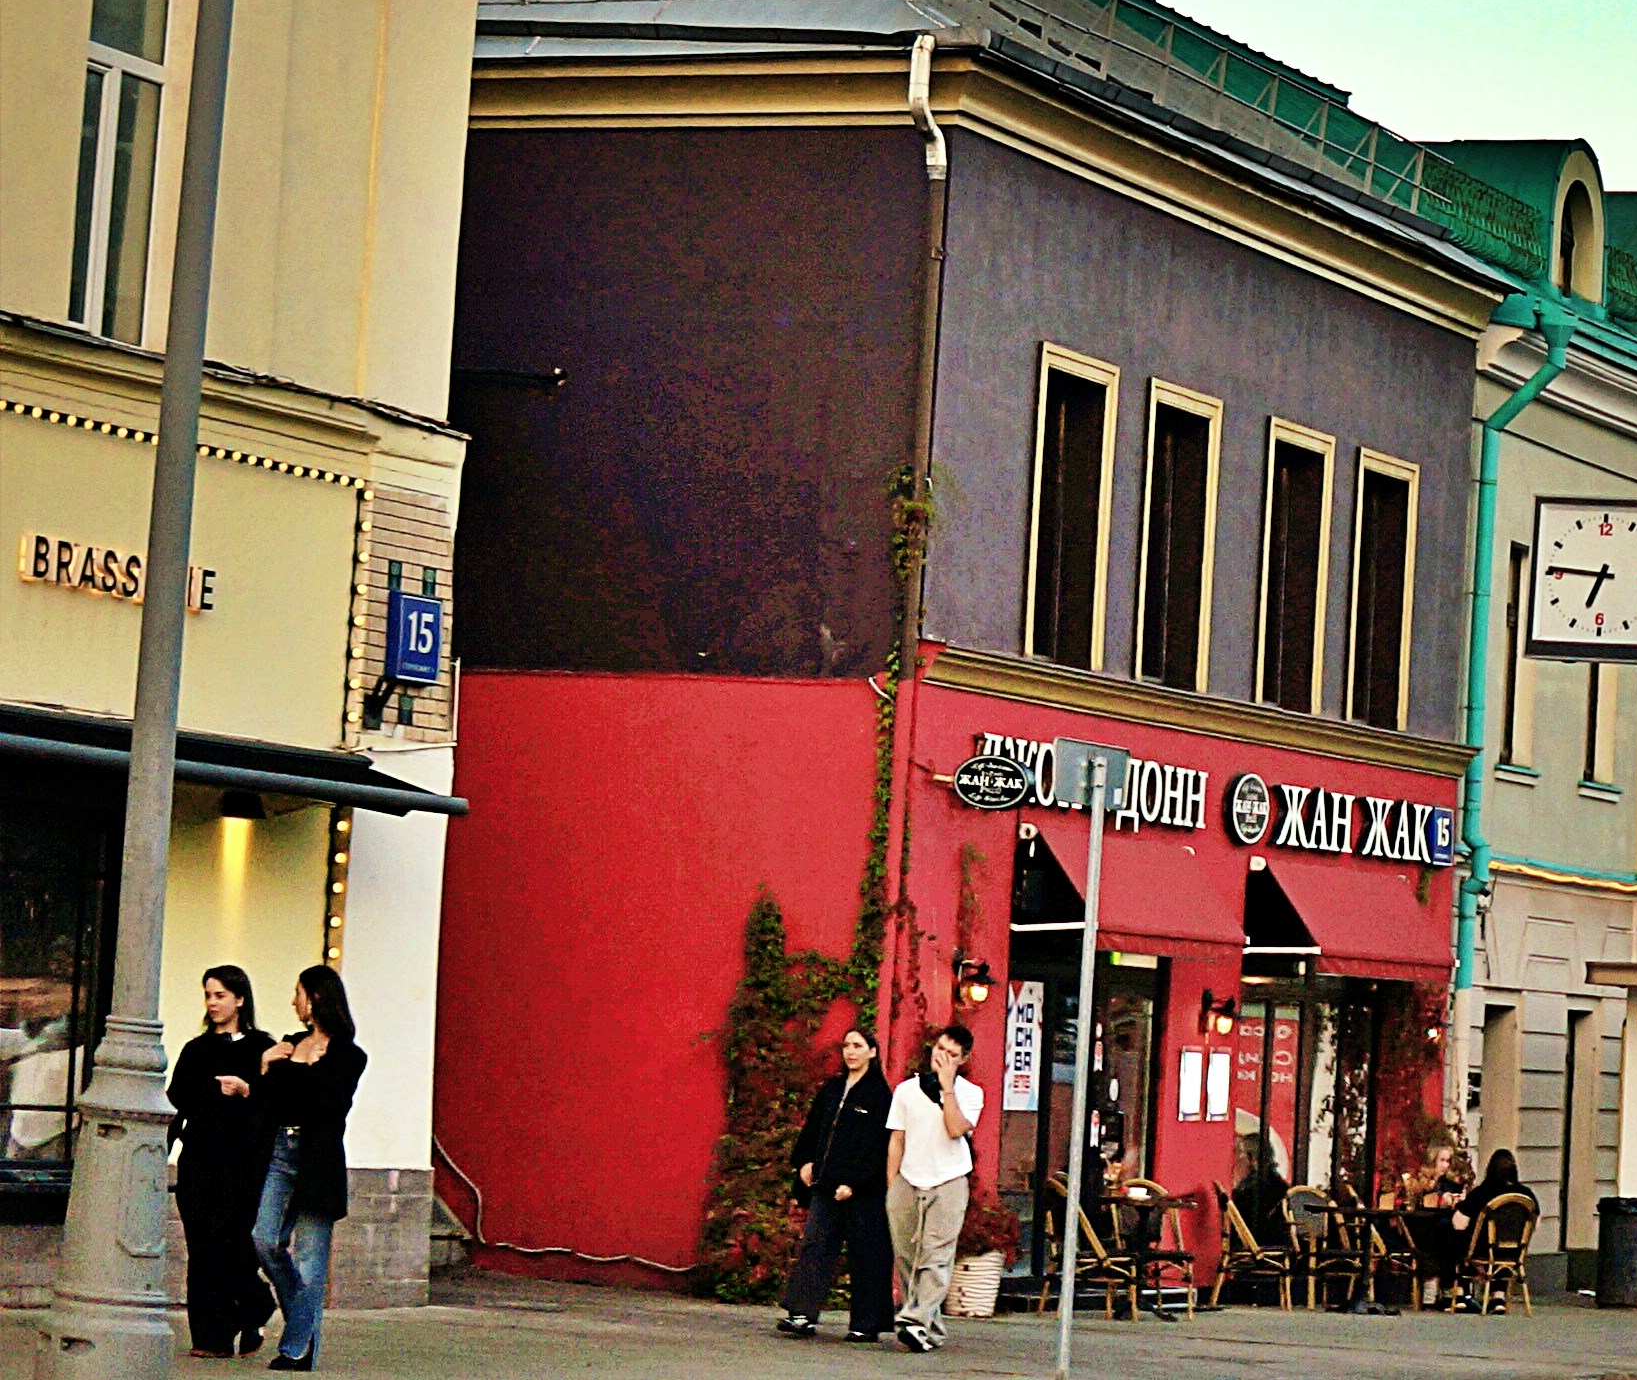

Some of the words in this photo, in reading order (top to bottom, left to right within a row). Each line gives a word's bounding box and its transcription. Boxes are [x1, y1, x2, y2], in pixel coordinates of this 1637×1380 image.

[1598, 523, 1613, 536] 12
[33, 535, 216, 610] BRASSIE
[408, 611, 434, 654] 15
[1594, 612, 1605, 626] 6
[1276, 784, 1355, 853] ЖАН
[1362, 796, 1433, 863] ЖАК
[1436, 817, 1450, 847] 15
